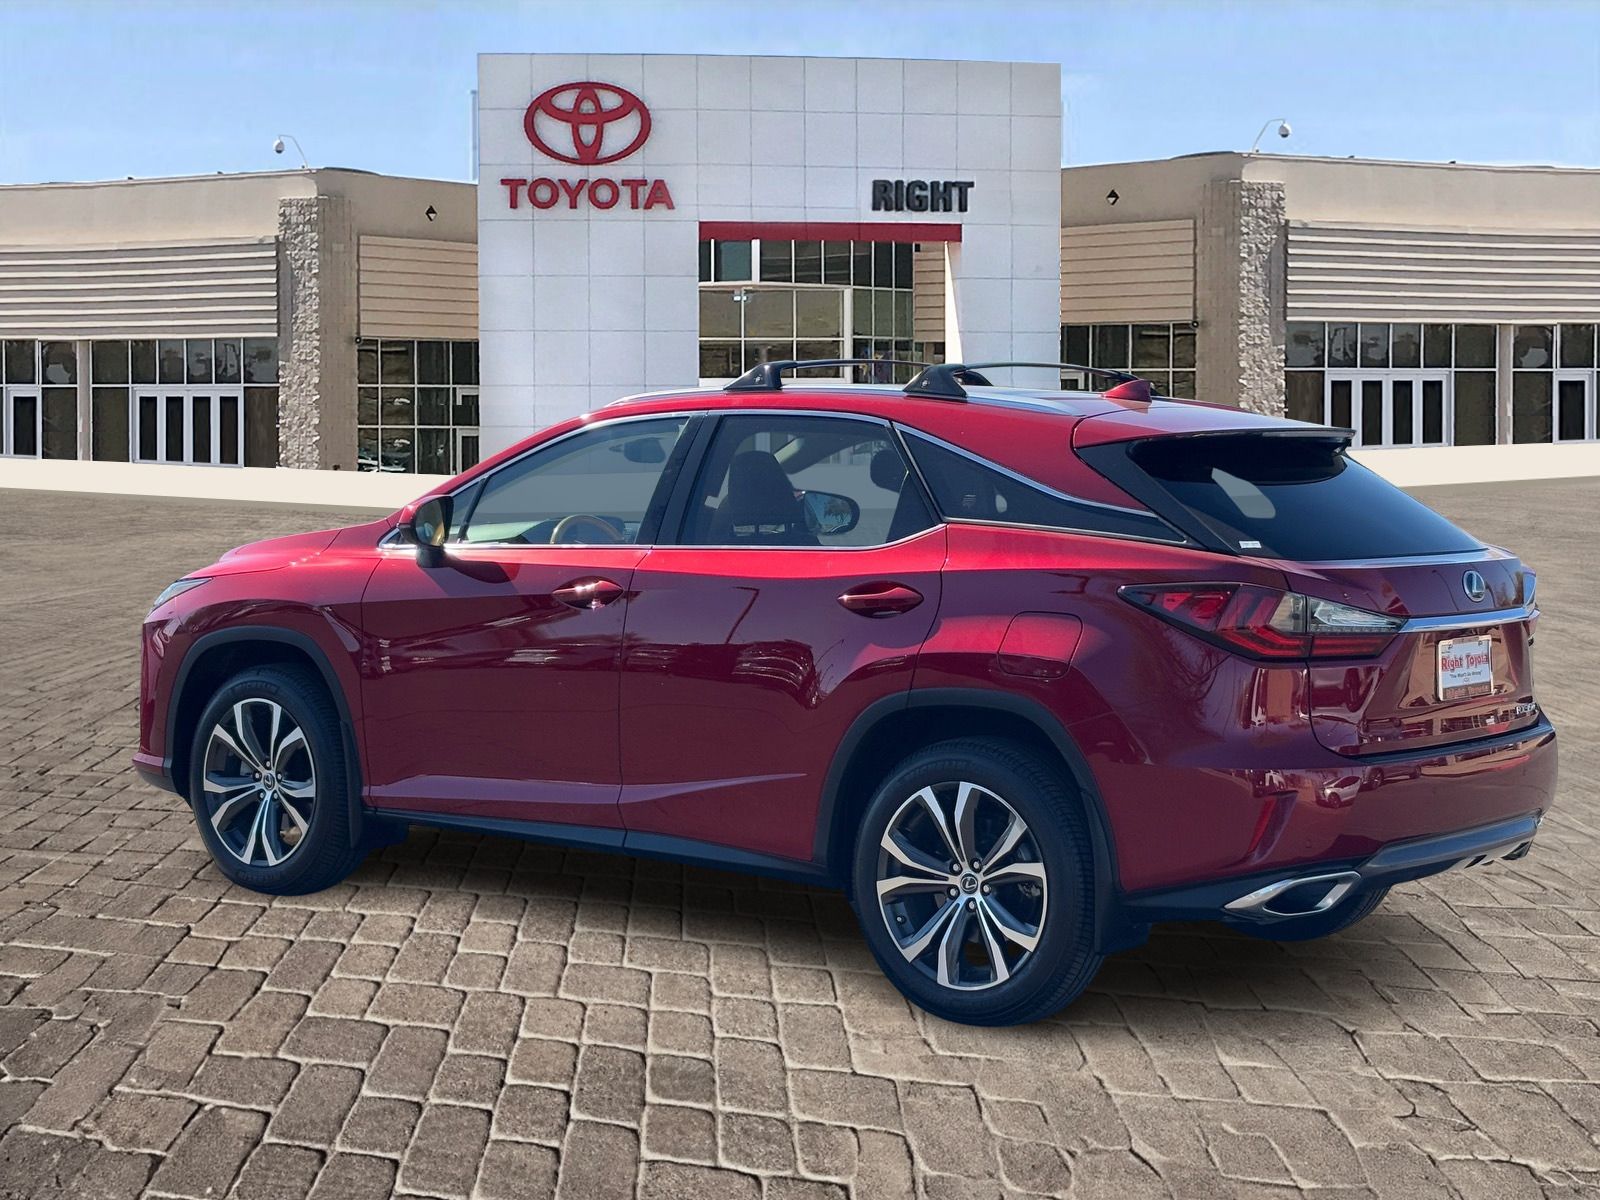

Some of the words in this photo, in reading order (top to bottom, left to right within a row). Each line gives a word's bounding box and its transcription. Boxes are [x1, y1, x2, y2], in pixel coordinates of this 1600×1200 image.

[501, 178, 675, 210] TOYOTA
[872, 179, 974, 212] RIGHT
[1441, 656, 1463, 672] Right
